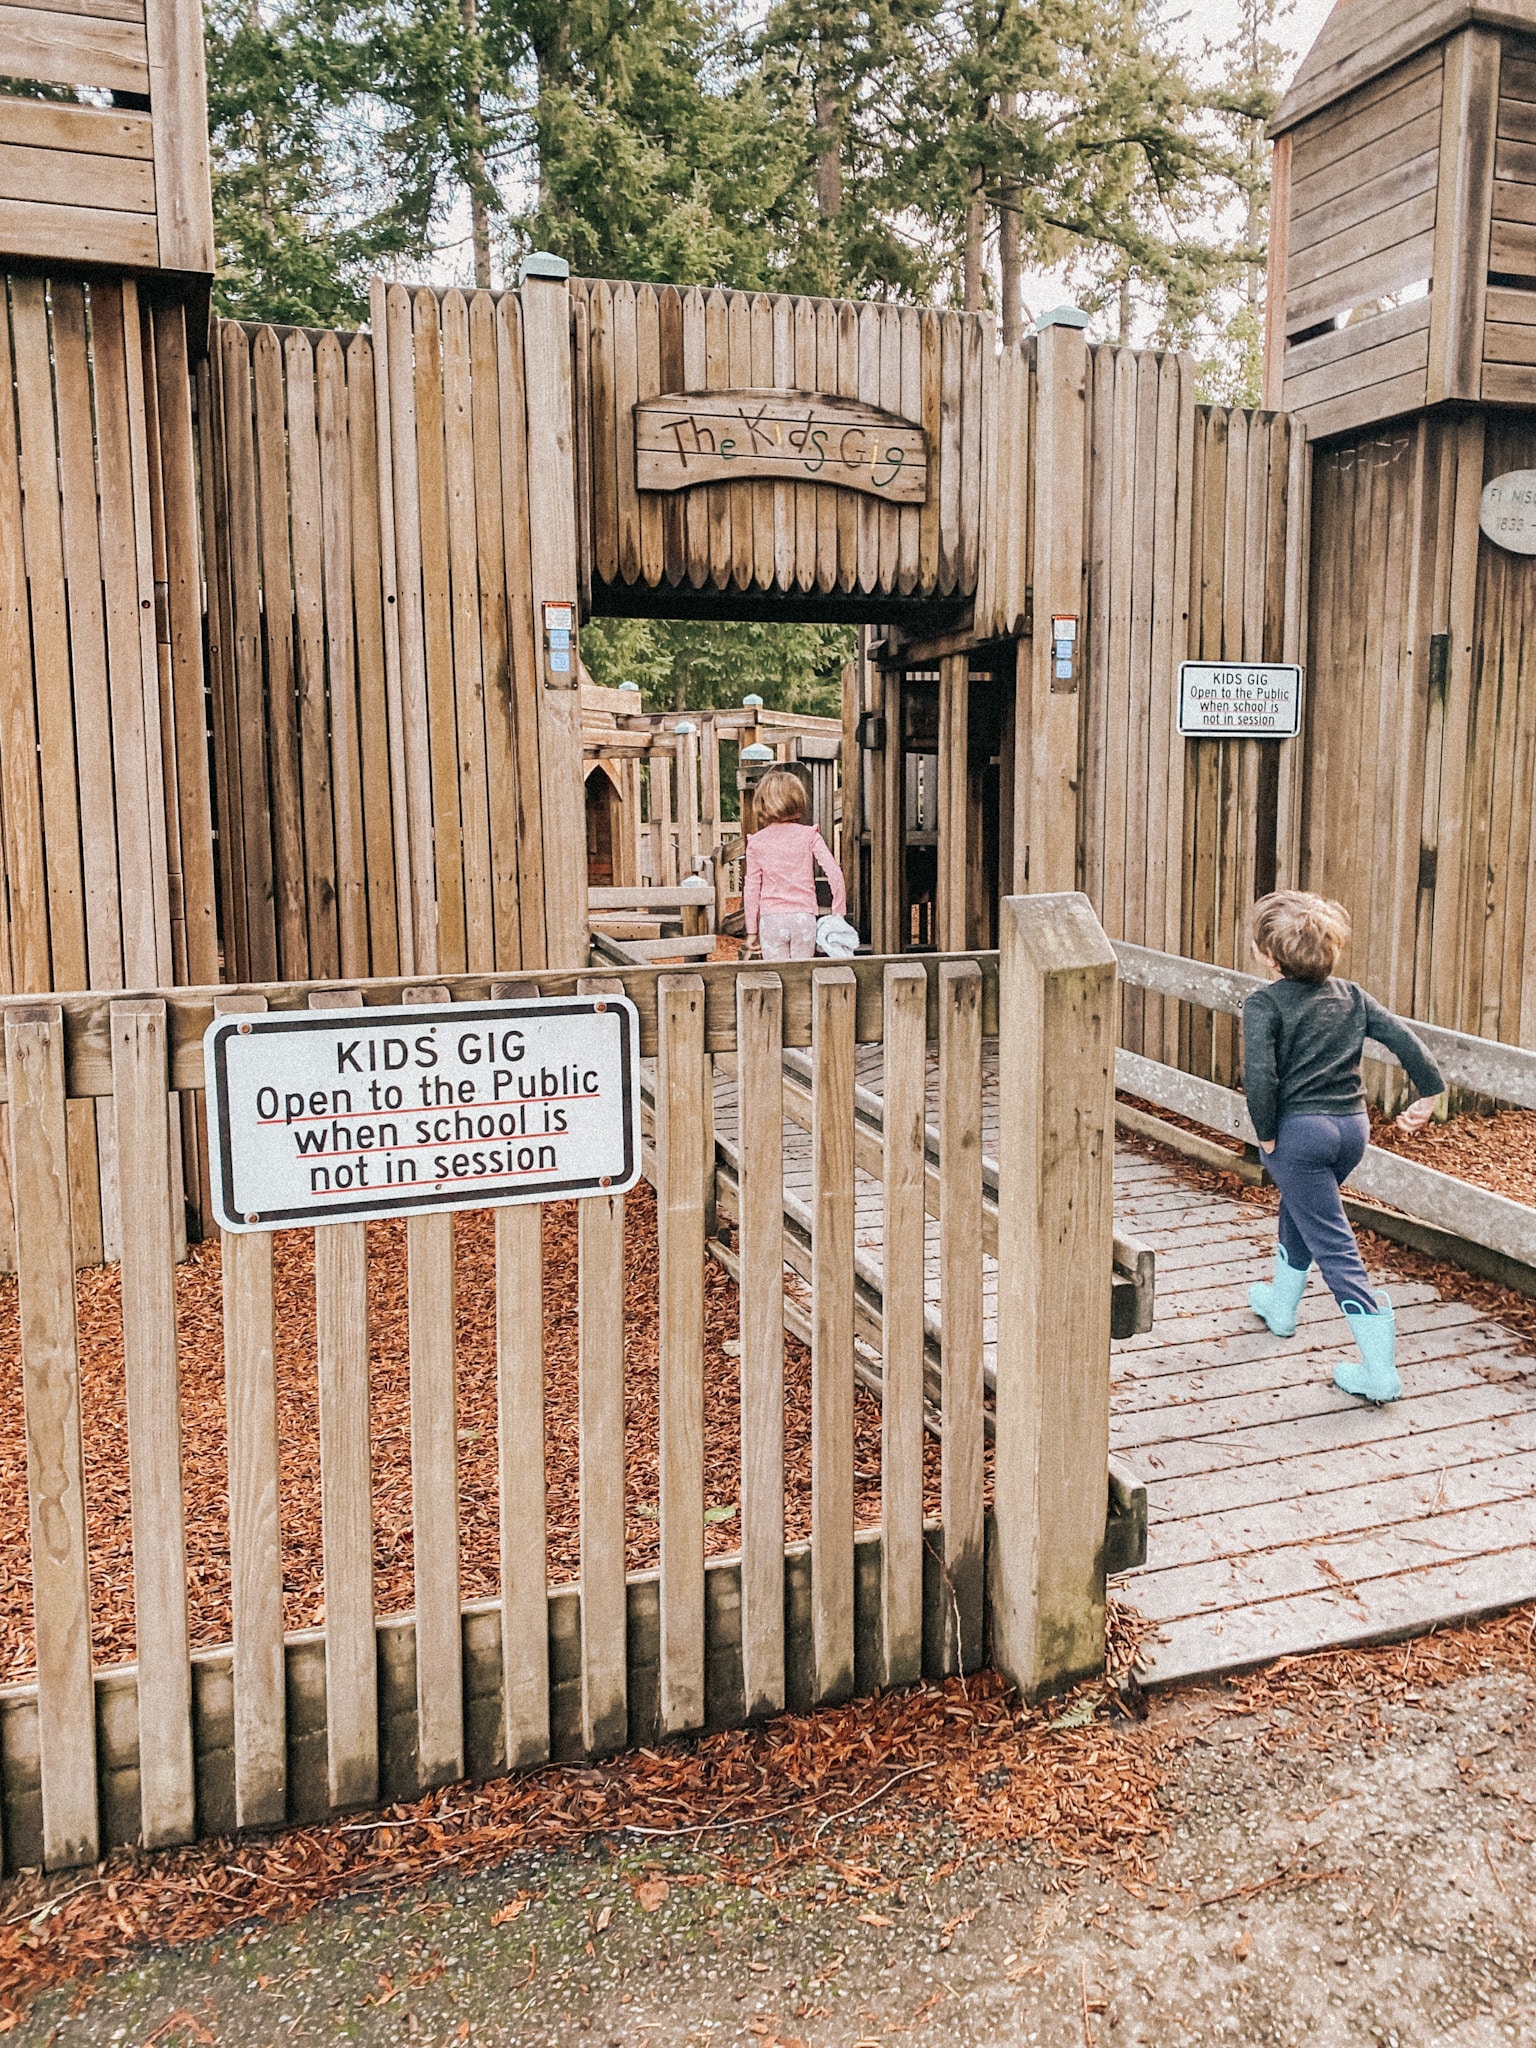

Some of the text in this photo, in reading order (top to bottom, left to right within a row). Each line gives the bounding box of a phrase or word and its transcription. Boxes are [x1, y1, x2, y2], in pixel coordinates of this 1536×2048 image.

[661, 403, 905, 487] The Kids Gig
[1190, 686, 1289, 700] Open to the Public
[1213, 673, 1268, 686] KIDS GIG
[1200, 701, 1279, 713] when school is
[1203, 713, 1275, 726] not in session
[337, 1030, 526, 1074] KIDS GIG
[256, 1064, 600, 1125] Open to the Public
[294, 1102, 568, 1154] when school is
[311, 1141, 557, 1191] not in session
